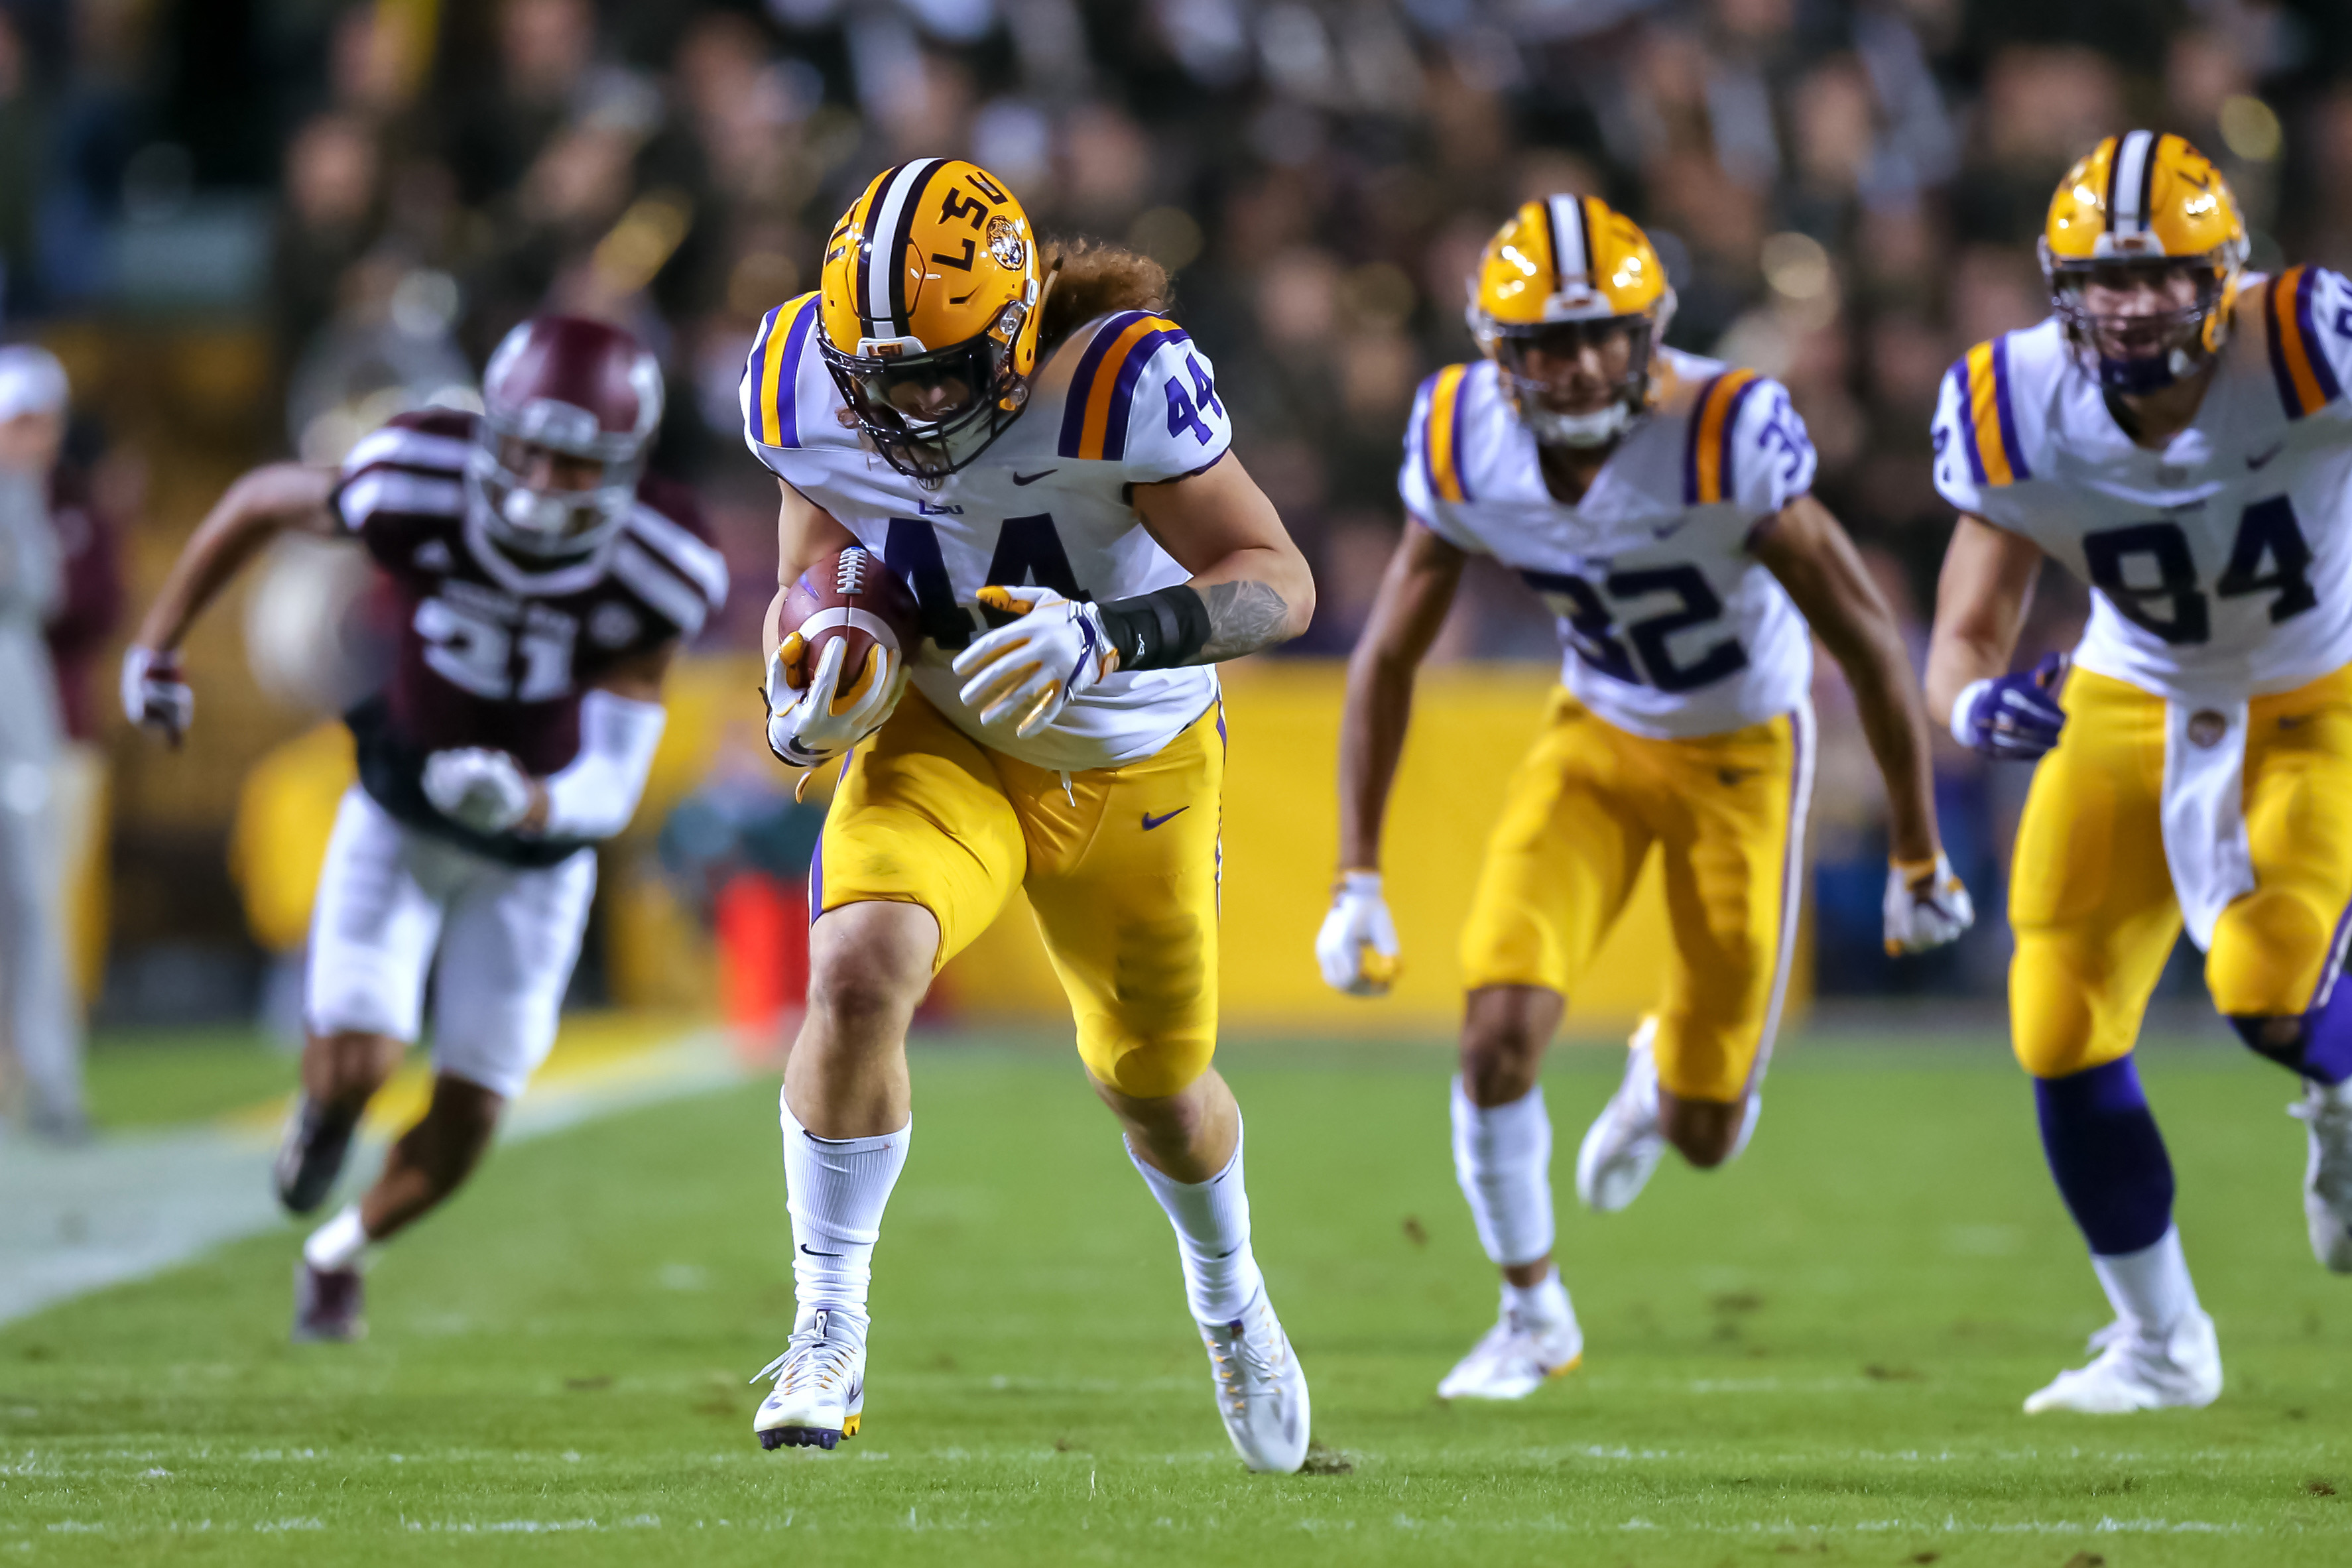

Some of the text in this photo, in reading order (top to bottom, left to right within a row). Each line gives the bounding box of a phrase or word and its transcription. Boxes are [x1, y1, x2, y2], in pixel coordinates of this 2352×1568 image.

[931, 171, 1009, 272] LSU
[1164, 351, 1222, 446] 44
[884, 513, 1093, 650] 44
[1520, 565, 1747, 694] 32
